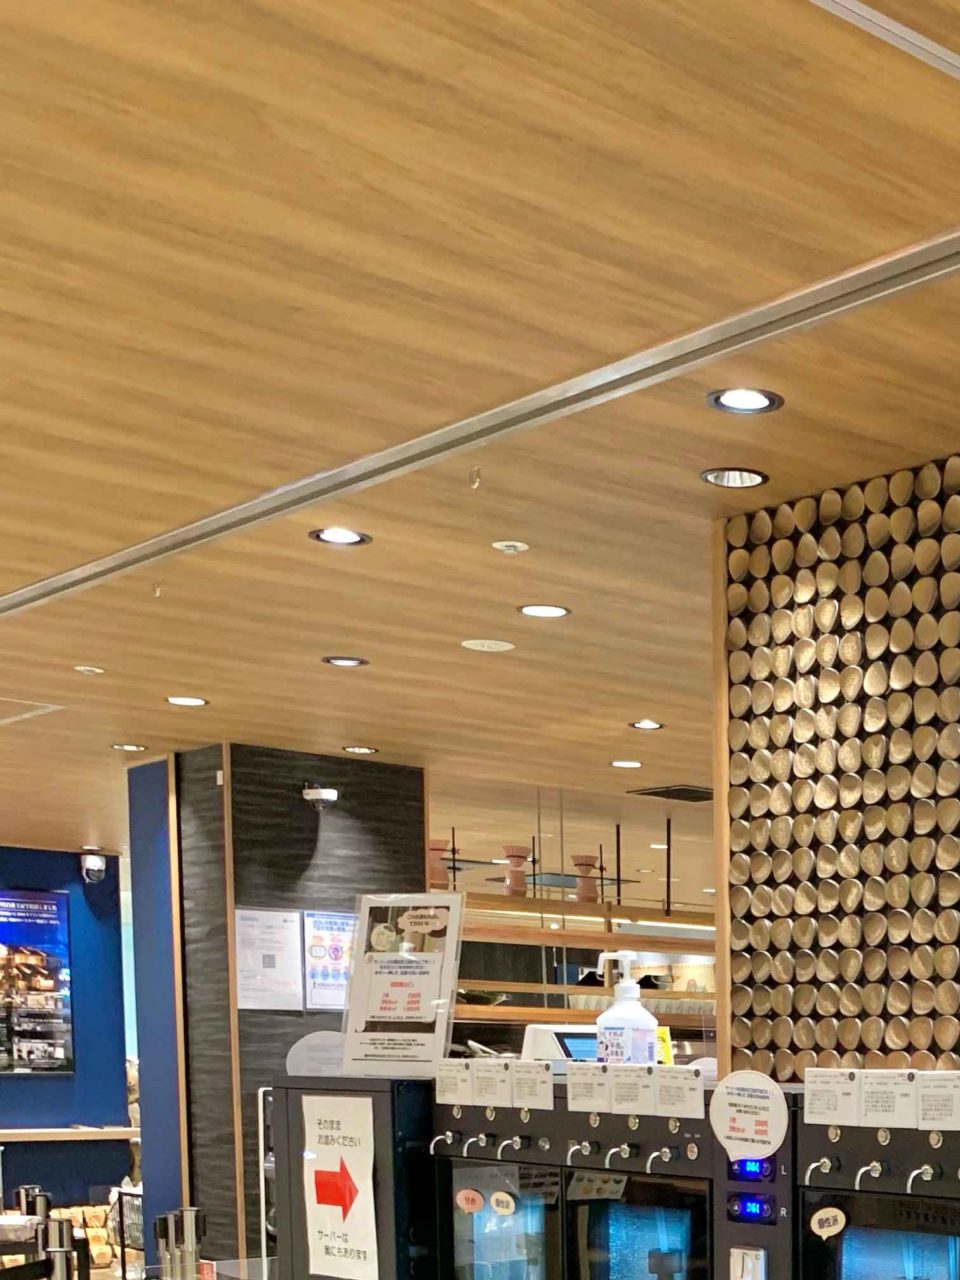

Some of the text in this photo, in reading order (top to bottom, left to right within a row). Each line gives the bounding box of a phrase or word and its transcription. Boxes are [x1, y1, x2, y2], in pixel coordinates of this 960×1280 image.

[317, 1119, 342, 1131] そのまま
[318, 1134, 361, 1147] お進みください
[318, 1230, 348, 1243] サーバーは
